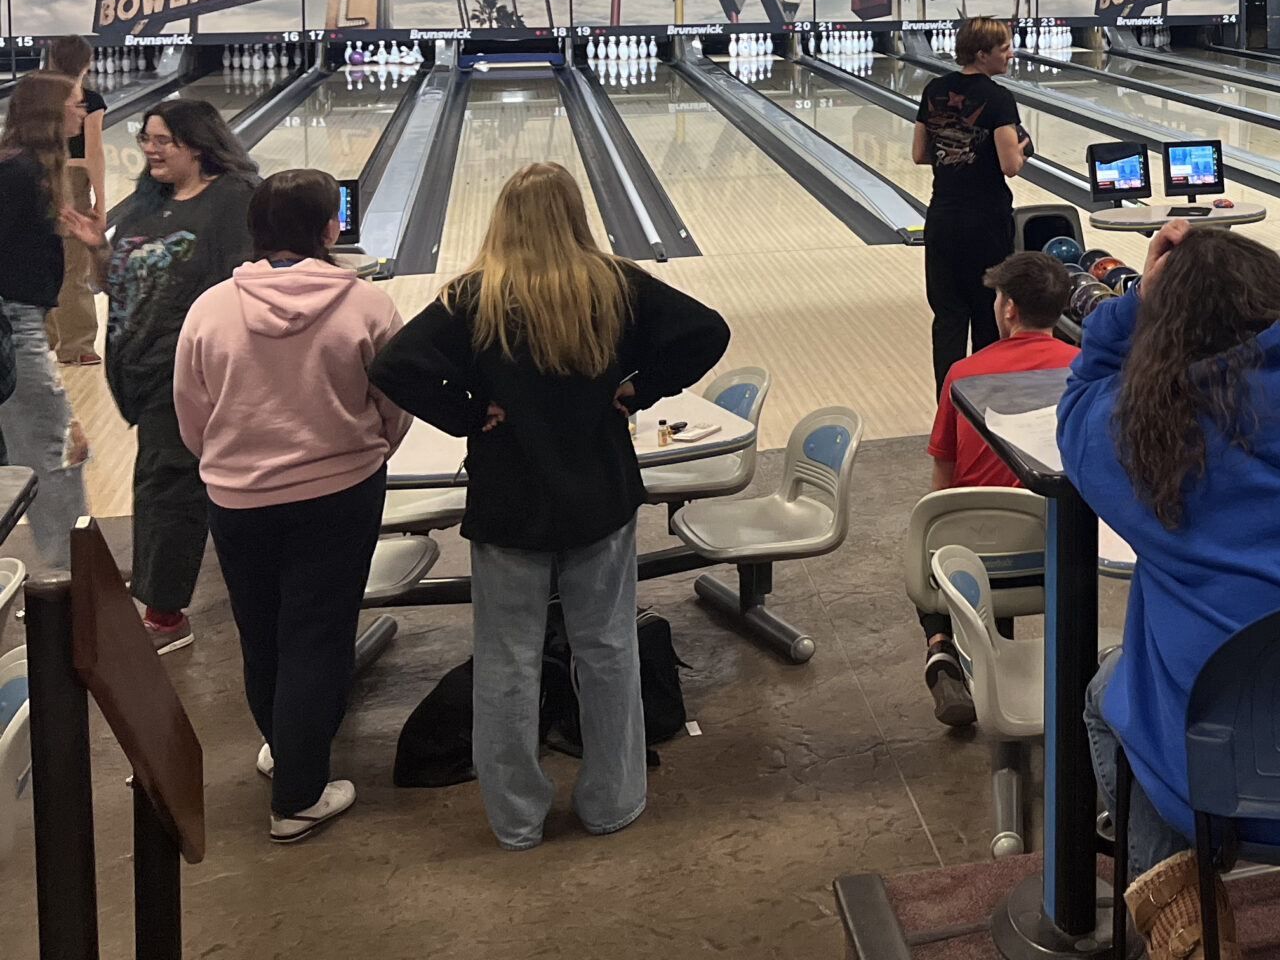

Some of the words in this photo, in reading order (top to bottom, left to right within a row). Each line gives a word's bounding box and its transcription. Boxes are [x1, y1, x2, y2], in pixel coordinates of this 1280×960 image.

[1019, 18, 1034, 26] 22
[1041, 18, 1056, 27] 23
[1116, 15, 1164, 26] Brunswick
[1222, 14, 1236, 23] 24
[667, 23, 723, 35] Brunswick
[795, 21, 811, 31] 20
[818, 21, 833, 31] 21
[902, 20, 953, 30] Brunswick
[309, 31, 325, 40] 17
[410, 28, 471, 39] Brunswick
[552, 27, 567, 37] 18
[576, 26, 591, 36] 19
[16, 36, 34, 47] 15
[125, 35, 193, 46] Brunswick
[282, 32, 299, 42] 16
